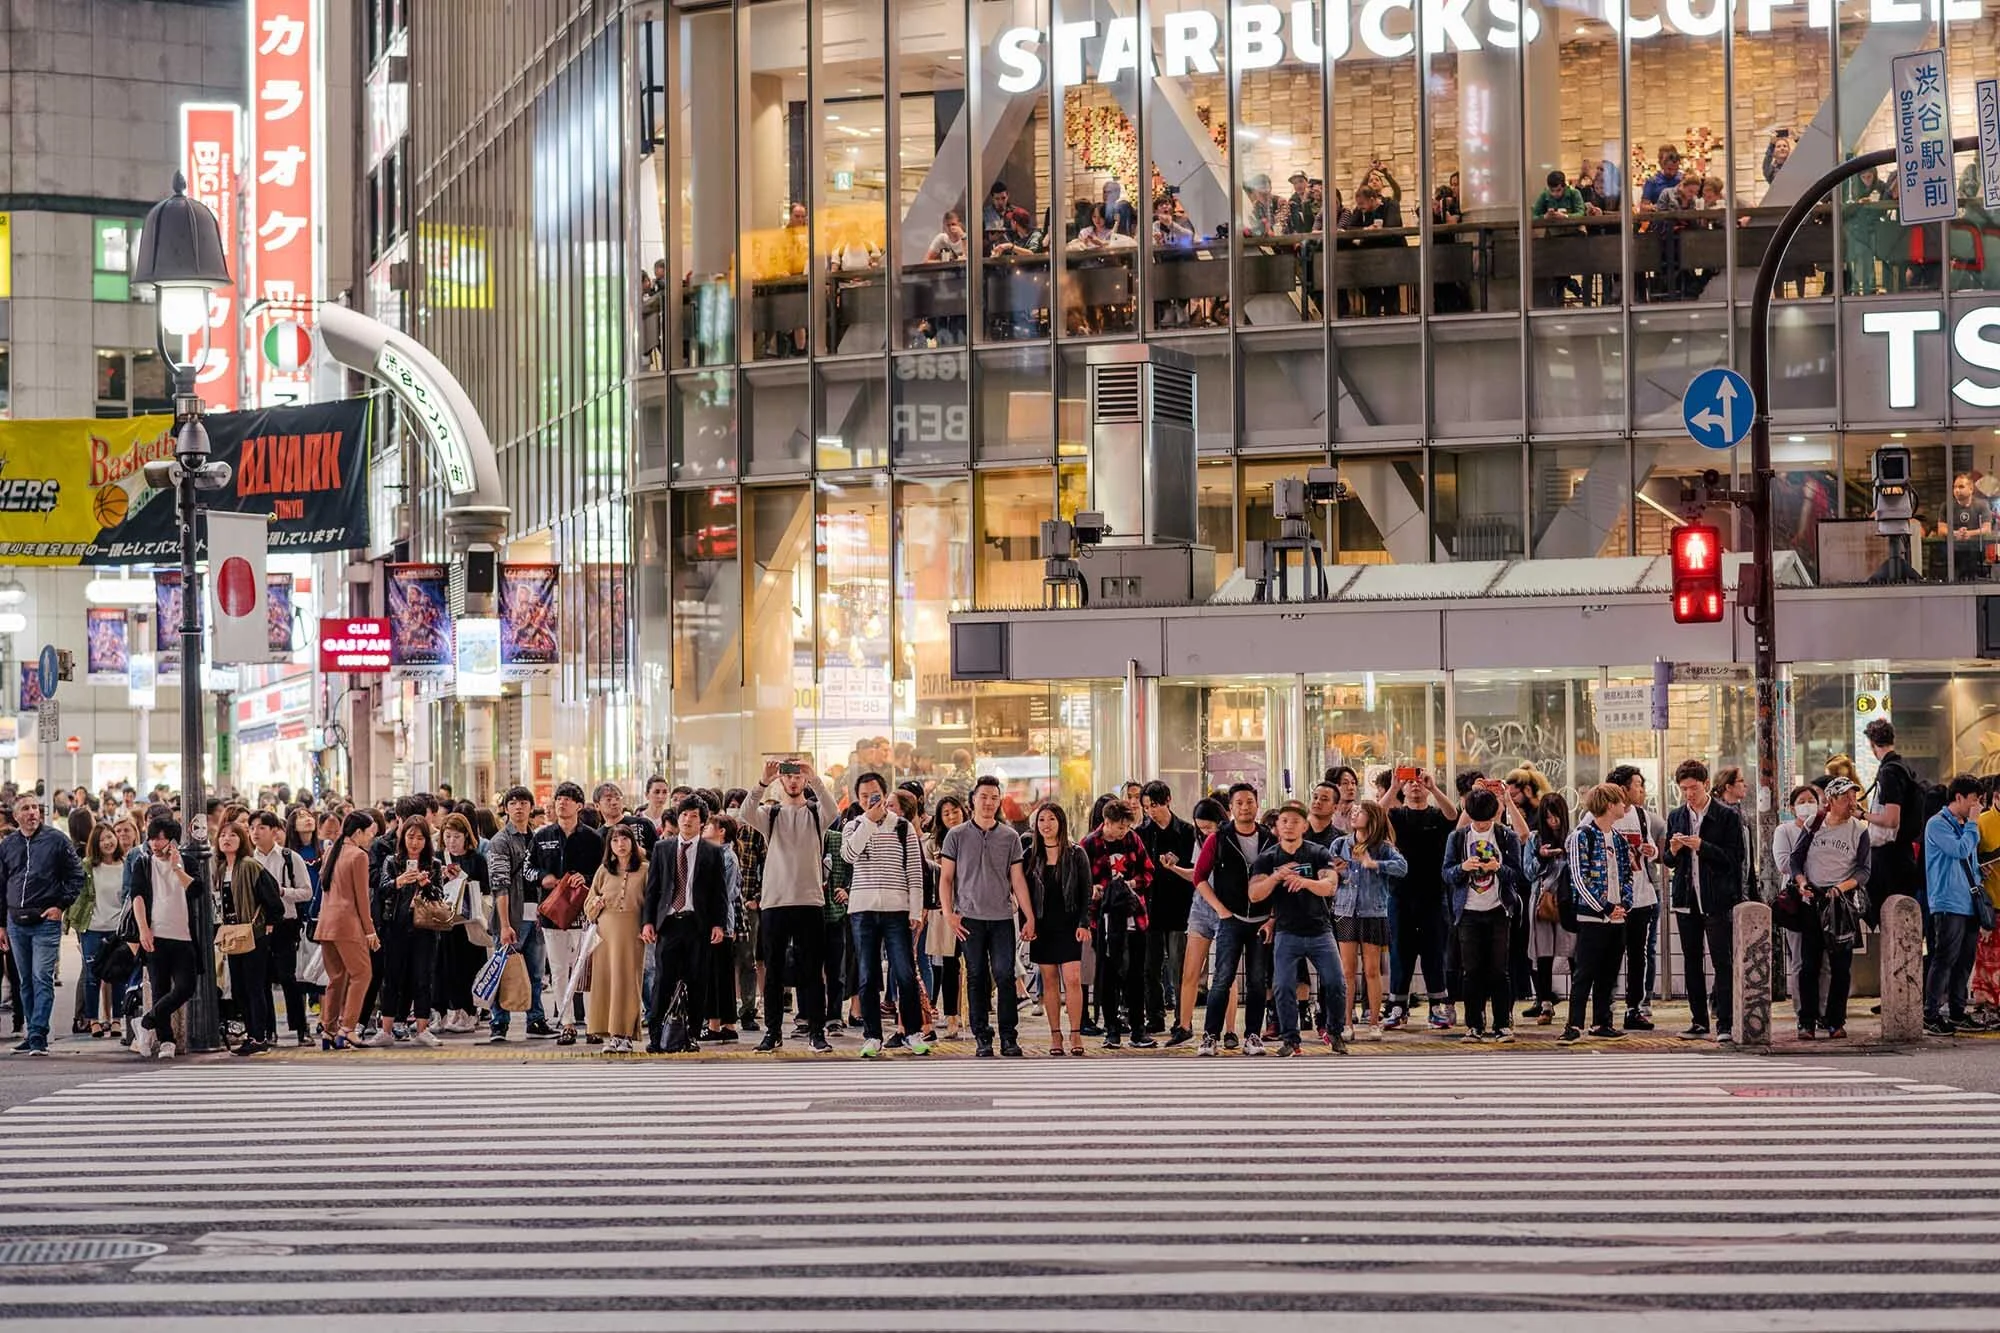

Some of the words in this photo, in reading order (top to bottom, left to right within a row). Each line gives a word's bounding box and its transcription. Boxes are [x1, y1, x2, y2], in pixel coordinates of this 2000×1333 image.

[998, 0, 1541, 93] STARBUCKS
[258, 15, 308, 252] カラオケ
[1900, 90, 1915, 155] Shibuya
[1915, 64, 1949, 208] 渋谷駅前
[1905, 161, 1919, 193] Sta.
[385, 352, 464, 485] 渋谷センター街
[89, 431, 177, 488] Basketb
[236, 431, 344, 498] ALVARK
[347, 623, 380, 635] CLUB
